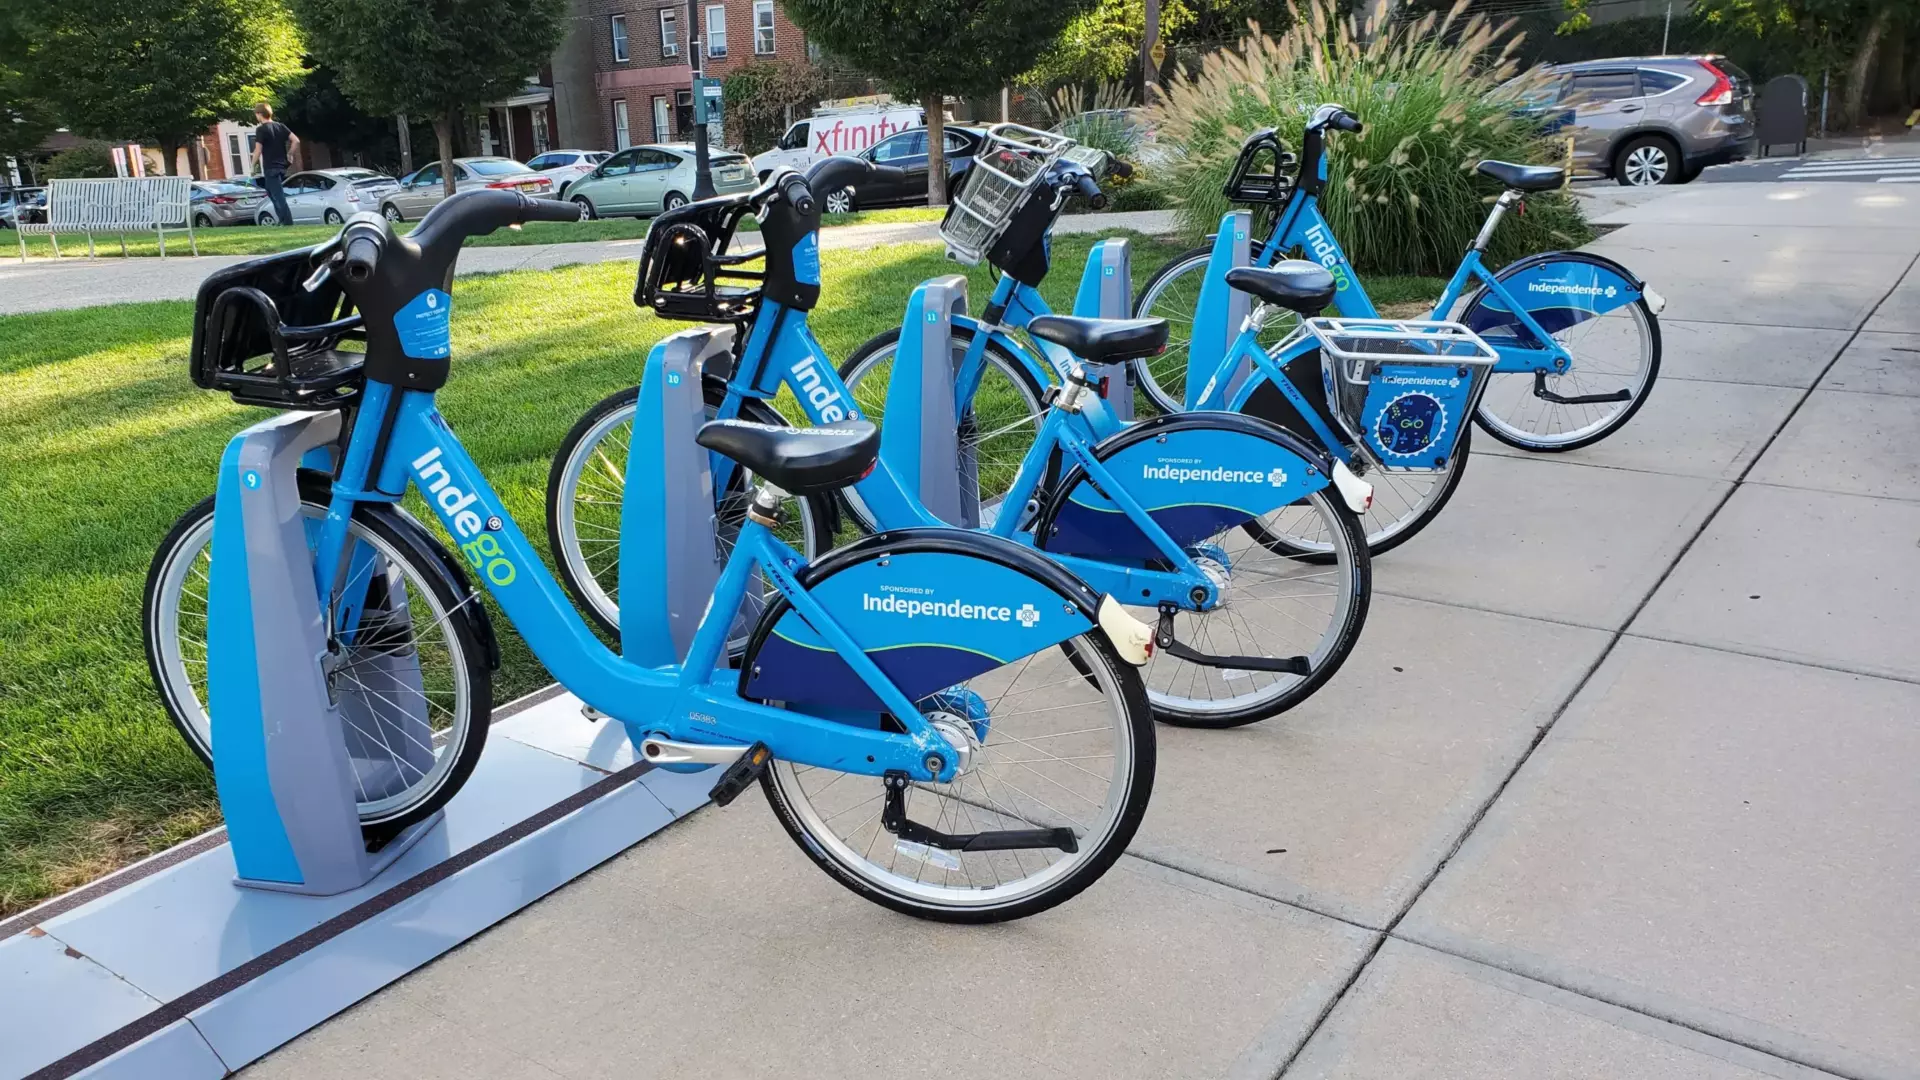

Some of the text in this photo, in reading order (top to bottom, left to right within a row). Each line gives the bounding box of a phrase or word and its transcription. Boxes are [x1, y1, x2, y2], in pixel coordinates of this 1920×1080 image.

[815, 116, 910, 156] xfinity
[1528, 282, 1603, 295] Independence
[927, 312, 936, 321] 11
[668, 374, 680, 384] 10
[790, 355, 843, 424] Inde
[247, 473, 256, 487] 9
[1143, 464, 1265, 483] Independence
[411, 446, 517, 587] Indego
[767, 560, 797, 597] TREK
[880, 585, 923, 594] SPONSORED
[863, 593, 1011, 622] Independence
